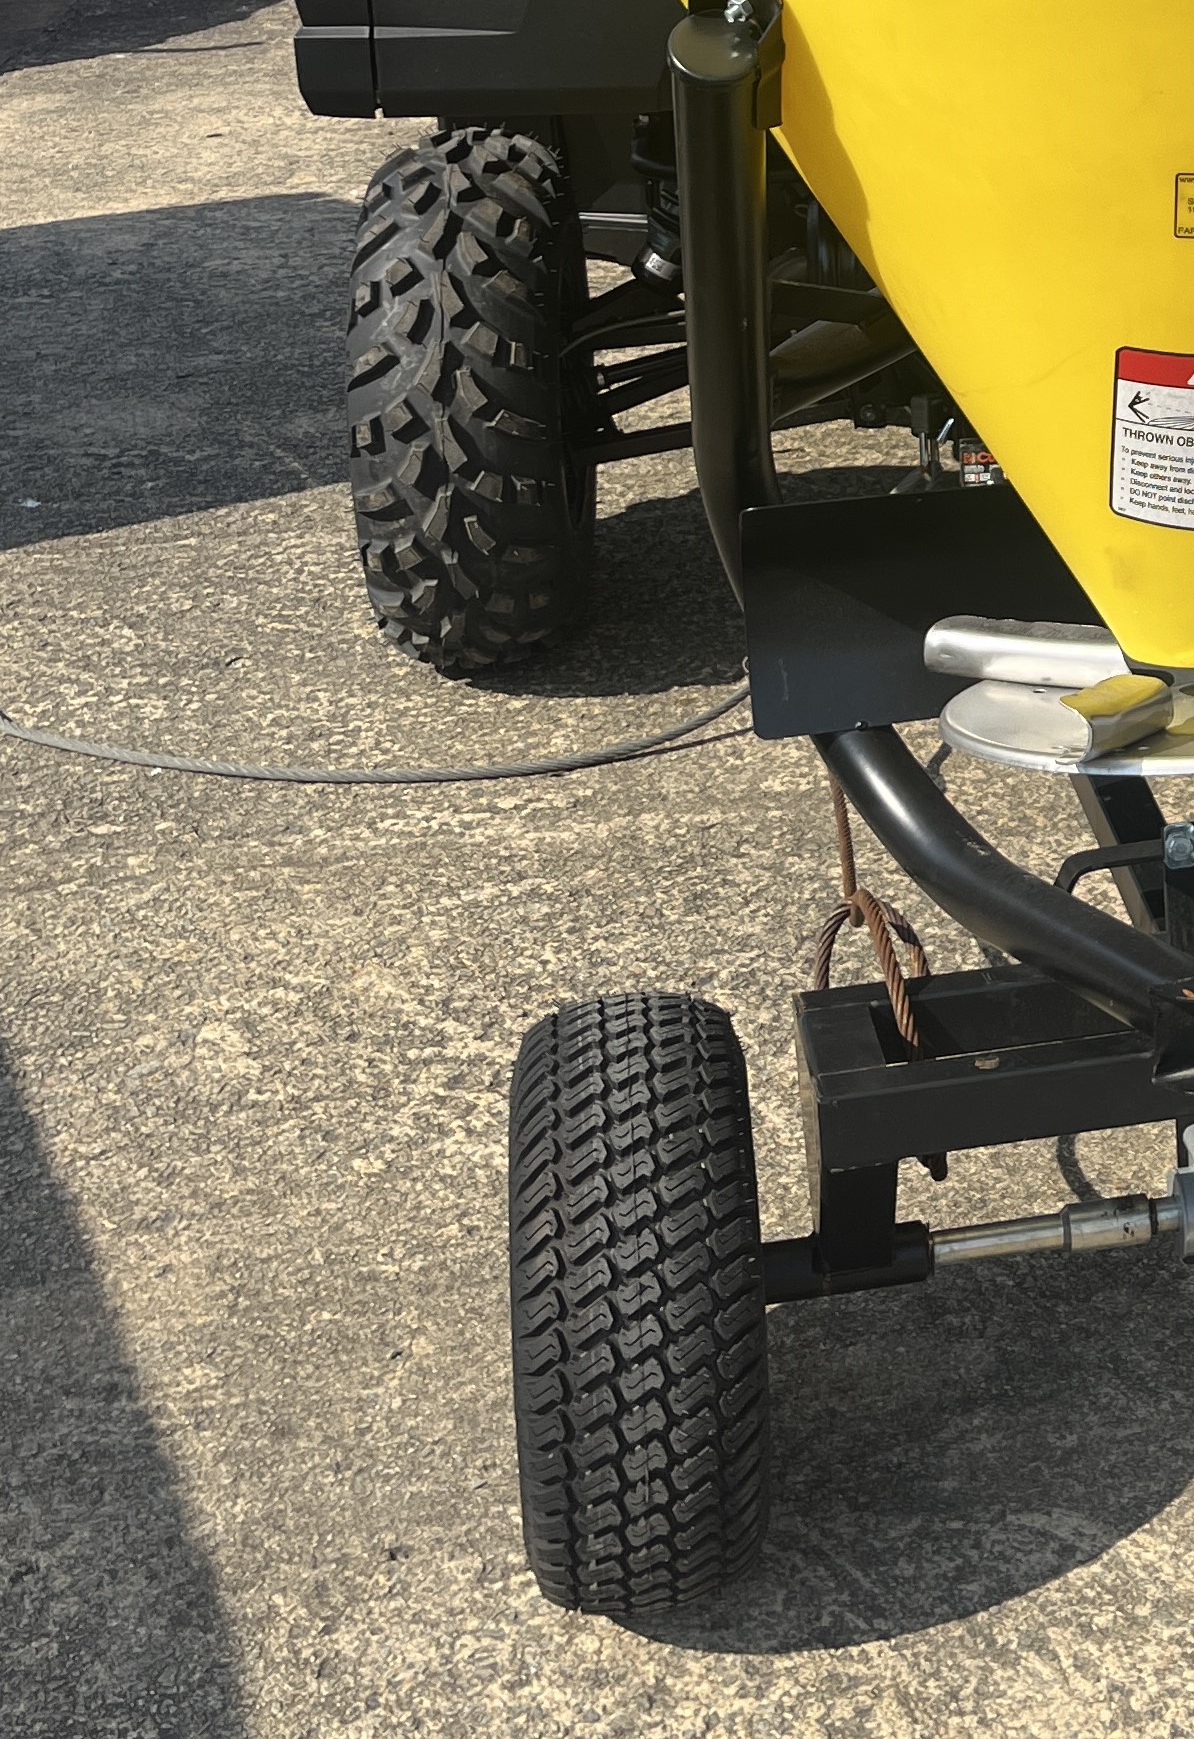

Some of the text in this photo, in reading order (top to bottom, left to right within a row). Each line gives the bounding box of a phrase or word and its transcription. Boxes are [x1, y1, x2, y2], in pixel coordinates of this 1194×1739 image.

[1122, 427, 1174, 446] THROWN
[1121, 445, 1129, 453] To
[1130, 449, 1157, 460] prevent
[1158, 454, 1184, 463] serious
[1131, 458, 1149, 469] Keep
[1150, 463, 1168, 473] away
[1169, 465, 1186, 473] from
[1130, 468, 1148, 479] Keep
[1149, 472, 1172, 482] others
[1130, 478, 1168, 491] Disconnect
[1169, 485, 1182, 494] and
[1129, 487, 1141, 496] DO
[1141, 490, 1157, 500] NOT
[1158, 493, 1176, 503] point
[1129, 497, 1146, 509] Keep
